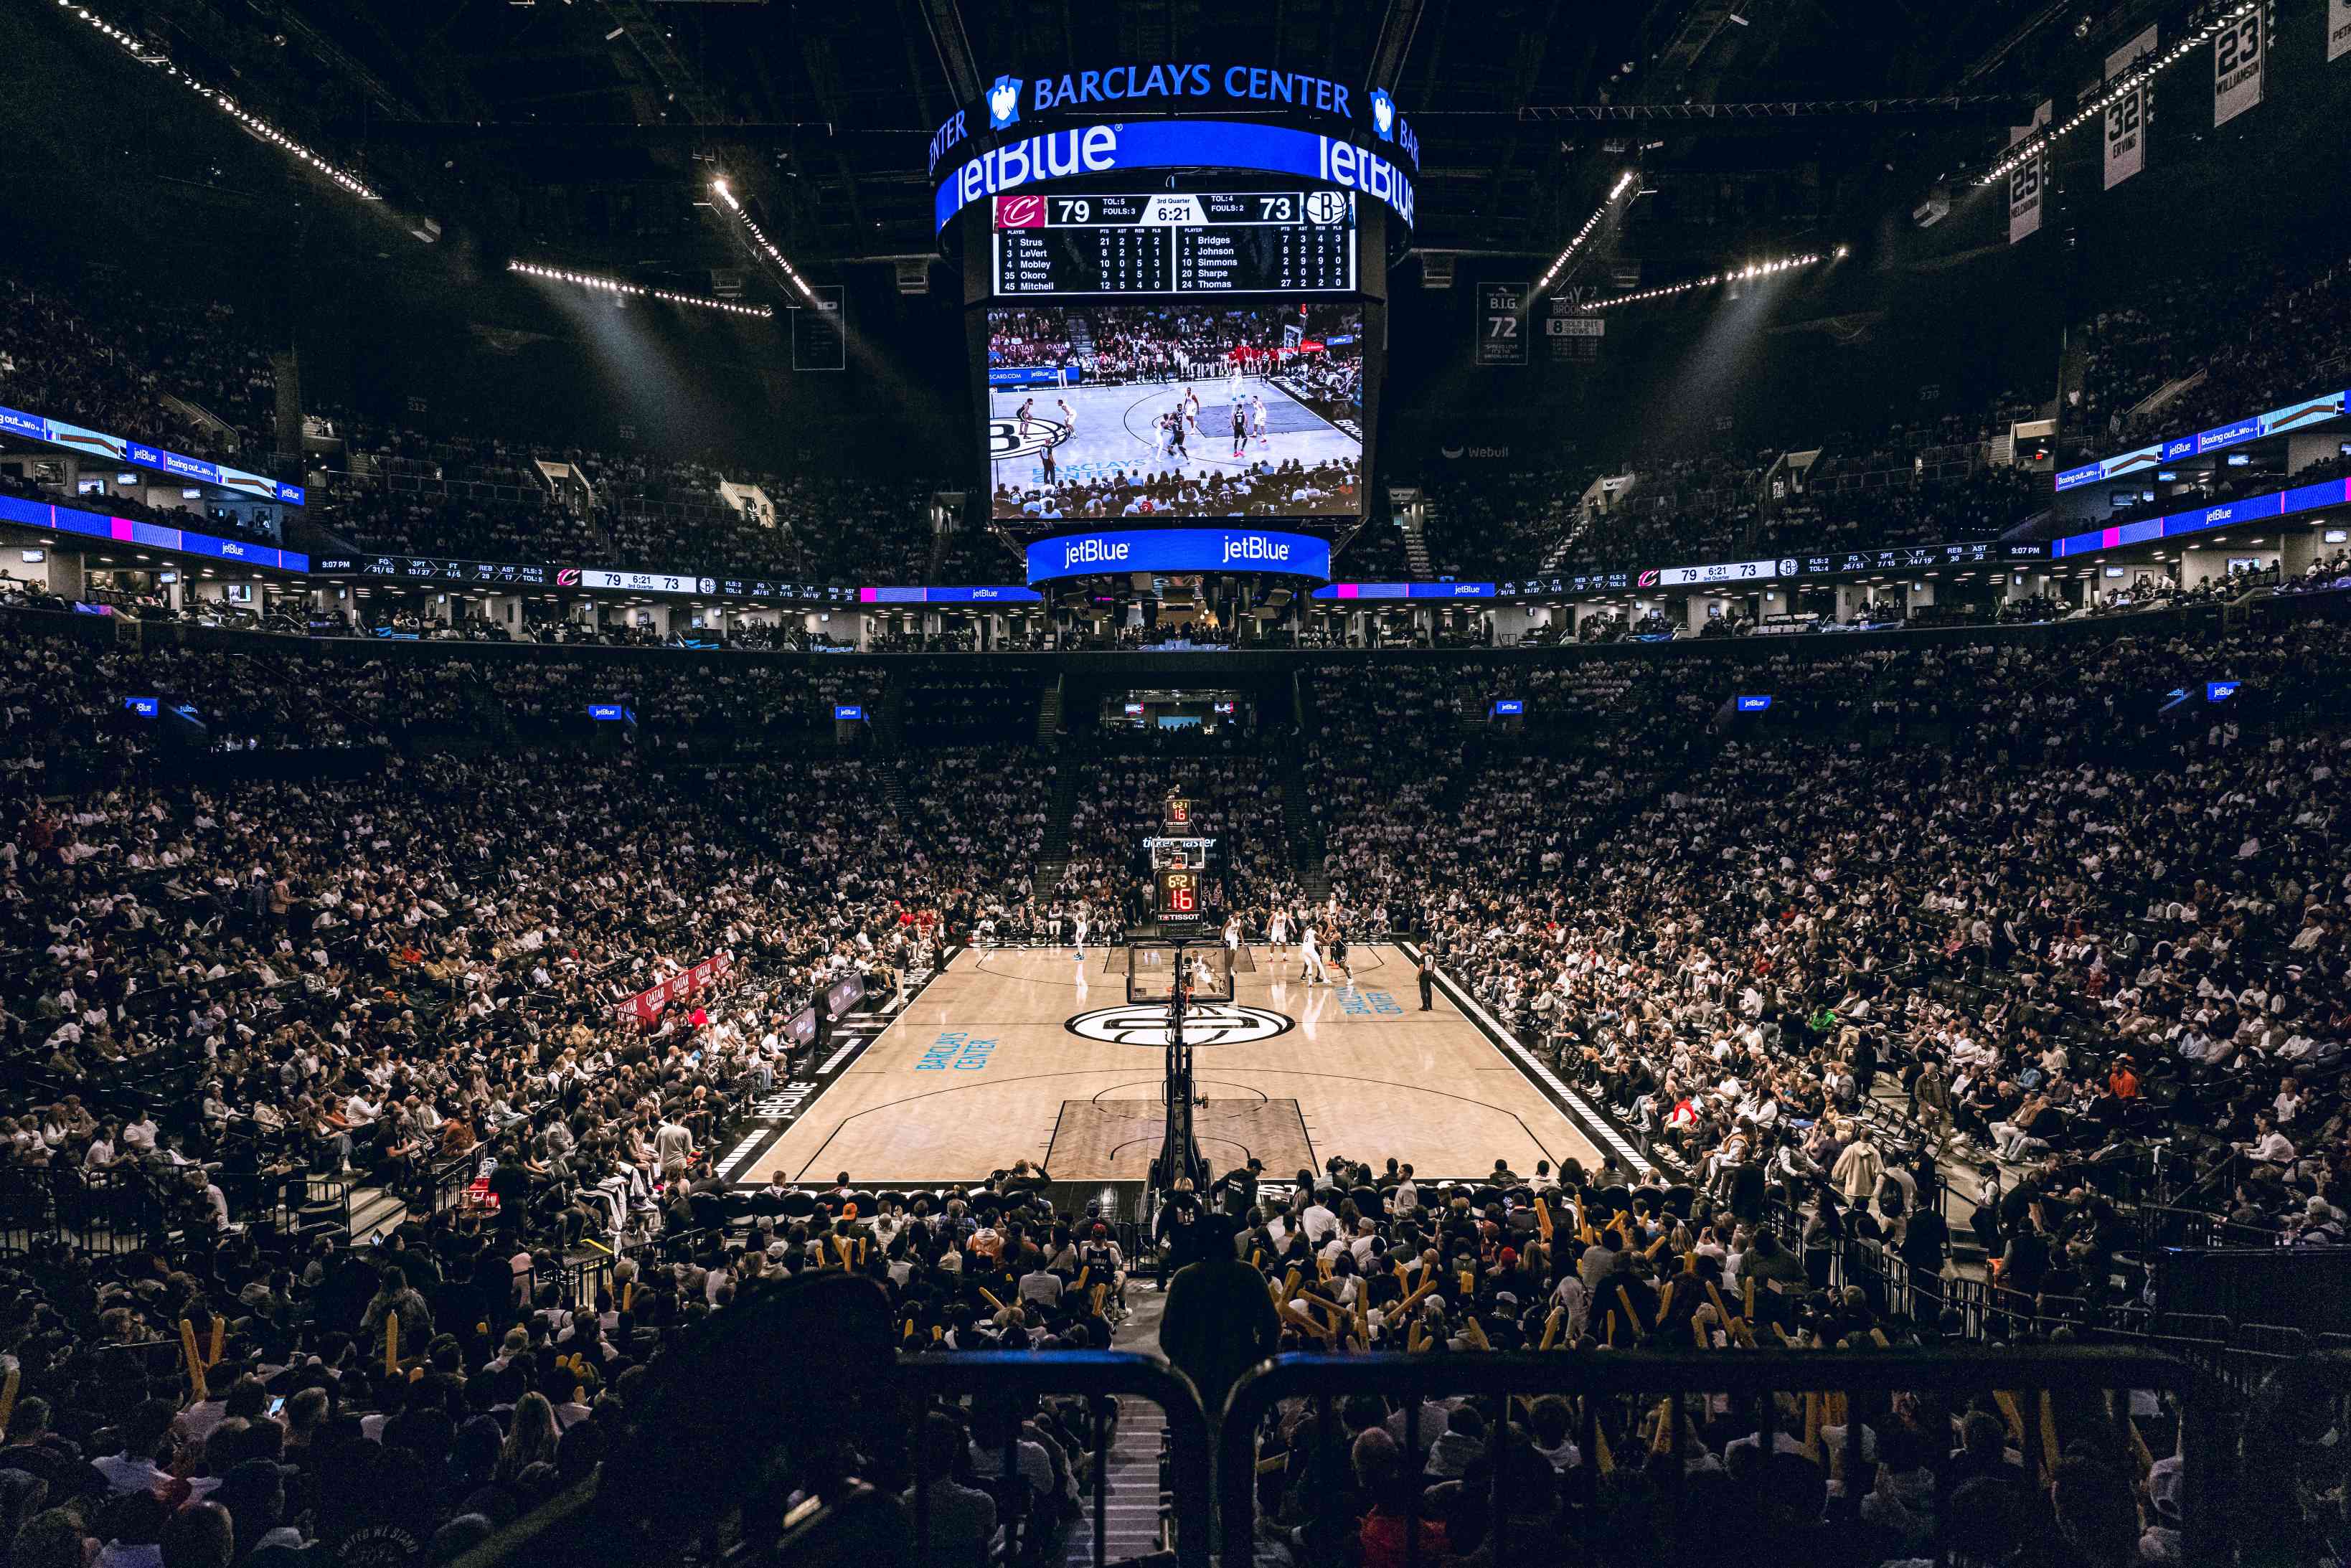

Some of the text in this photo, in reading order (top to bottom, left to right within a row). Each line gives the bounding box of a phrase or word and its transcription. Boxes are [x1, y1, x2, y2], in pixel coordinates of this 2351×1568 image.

[2218, 18, 2259, 75] 23
[2216, 62, 2260, 95] WILLIAMSON
[1034, 65, 1352, 118] BARCLAYS CENTER
[2109, 97, 2139, 141] 32
[2114, 133, 2136, 159] ERVING
[2012, 158, 2037, 204] 25
[1058, 201, 1090, 222] 79
[1158, 207, 1190, 221] 6:21
[1260, 198, 1291, 219] 73
[1021, 260, 1050, 269] Mobley
[1198, 270, 1228, 278] Sharpe
[1490, 298, 1518, 309] B.I.G.
[1488, 317, 1517, 337] 72
[1554, 321, 1562, 333] 8
[2201, 433, 2223, 445] Boxing
[133, 448, 156, 463] jetBlue
[1469, 447, 1508, 458] Webull
[2169, 442, 2191, 458] jetBlue
[282, 487, 299, 500] jetBlue
[2206, 509, 2231, 524] jetBlue
[222, 542, 244, 556] jetBlue
[1065, 539, 1130, 568] jetBlue
[1223, 536, 1289, 562] jetBlue
[1682, 570, 1697, 581] 79
[1740, 565, 1756, 576] 73
[605, 574, 621, 586] 79
[664, 578, 679, 590] 73
[1455, 585, 1479, 595] jetBlue
[1175, 809, 1185, 819] 16
[1169, 875, 1195, 887] 6:21
[1173, 889, 1192, 909] 16
[717, 956, 727, 969] QATA
[696, 964, 710, 982] QATAR
[673, 975, 689, 992] QATAR
[646, 987, 664, 1008] QATAR
[915, 1033, 968, 1070] BARCLAYS
[953, 1039, 999, 1069] CENTER
